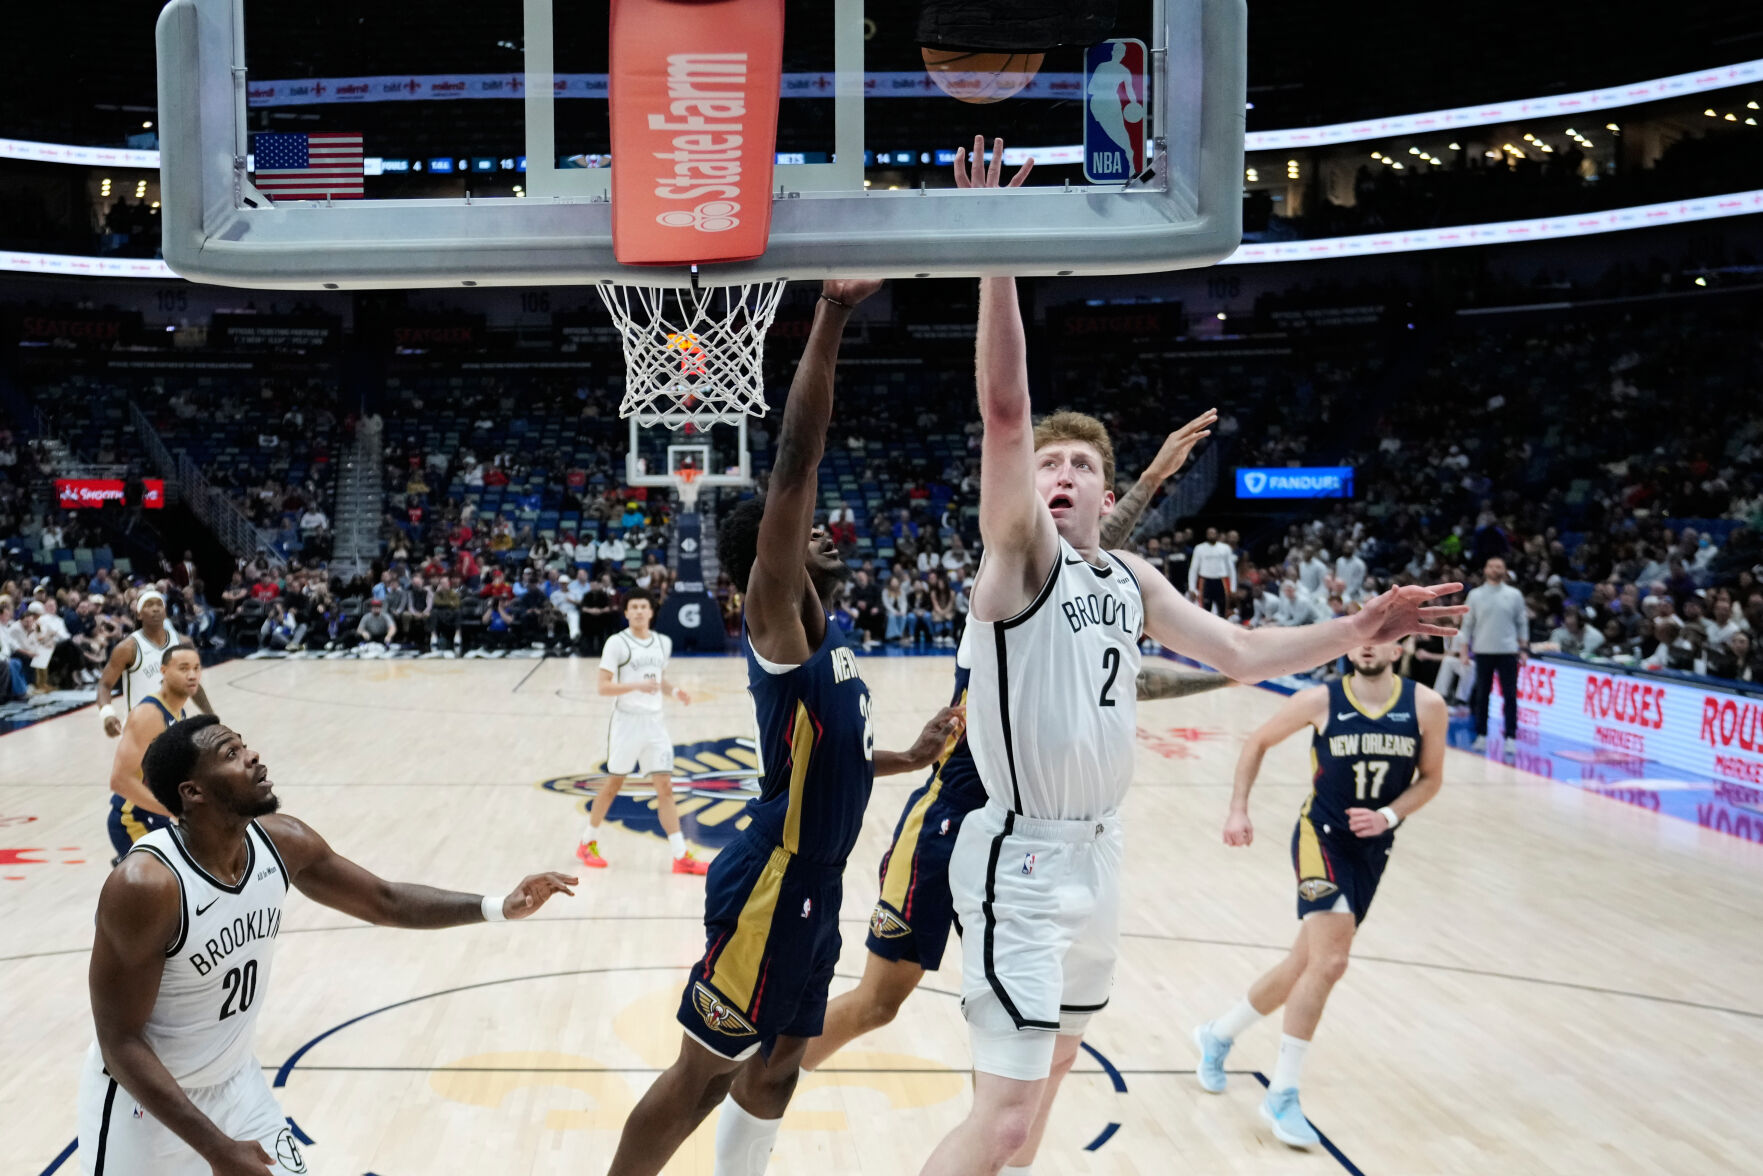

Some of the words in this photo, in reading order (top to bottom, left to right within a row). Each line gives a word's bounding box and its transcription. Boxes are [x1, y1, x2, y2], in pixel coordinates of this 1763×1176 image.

[1093, 151, 1122, 174] NBA
[678, 603, 701, 628] G
[1099, 648, 1120, 707] 2
[1584, 675, 1665, 729] ROUSES
[1329, 733, 1359, 757] NEW
[1361, 733, 1416, 757] ORLEANS
[1352, 761, 1389, 799] 17
[1714, 754, 1763, 784] MARKE
[219, 959, 257, 1021] 20
